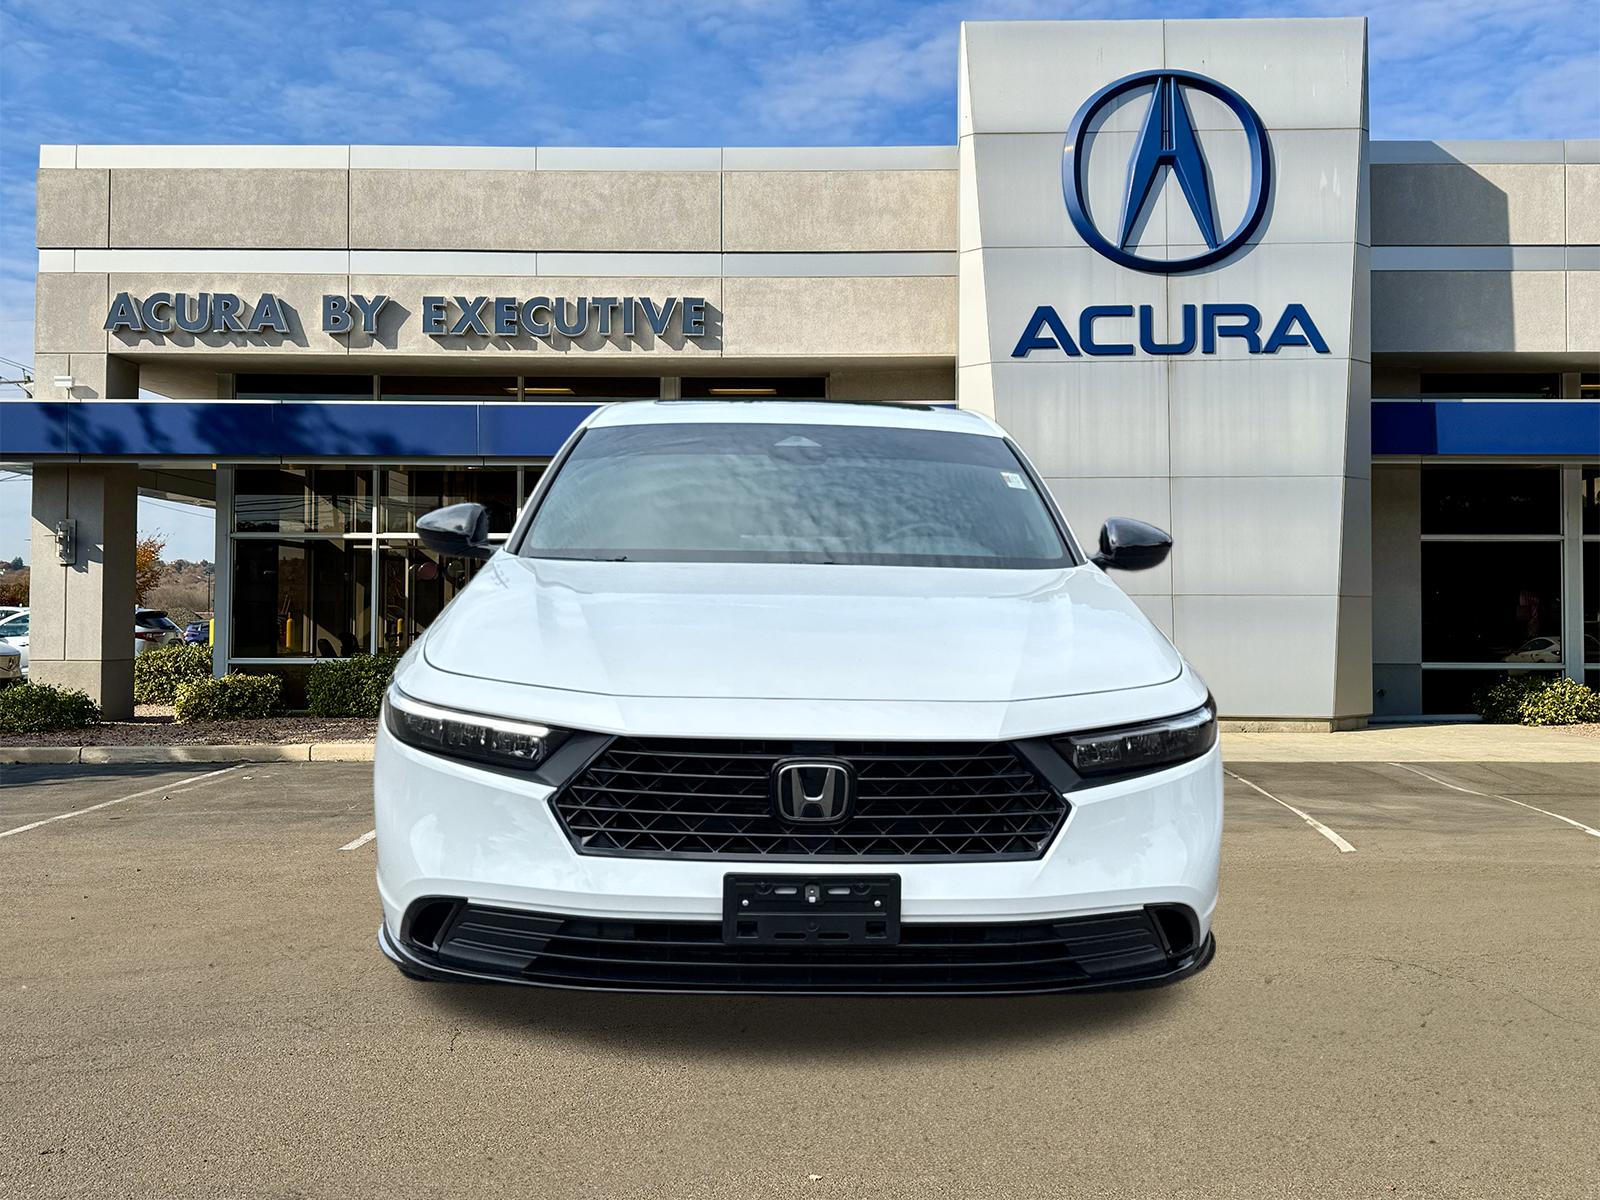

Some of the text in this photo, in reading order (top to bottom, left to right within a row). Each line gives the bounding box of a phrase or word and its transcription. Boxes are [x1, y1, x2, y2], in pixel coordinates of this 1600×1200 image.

[103, 291, 706, 338] ACURA BY EXECUTIVE
[1010, 302, 1332, 358] ACURA
